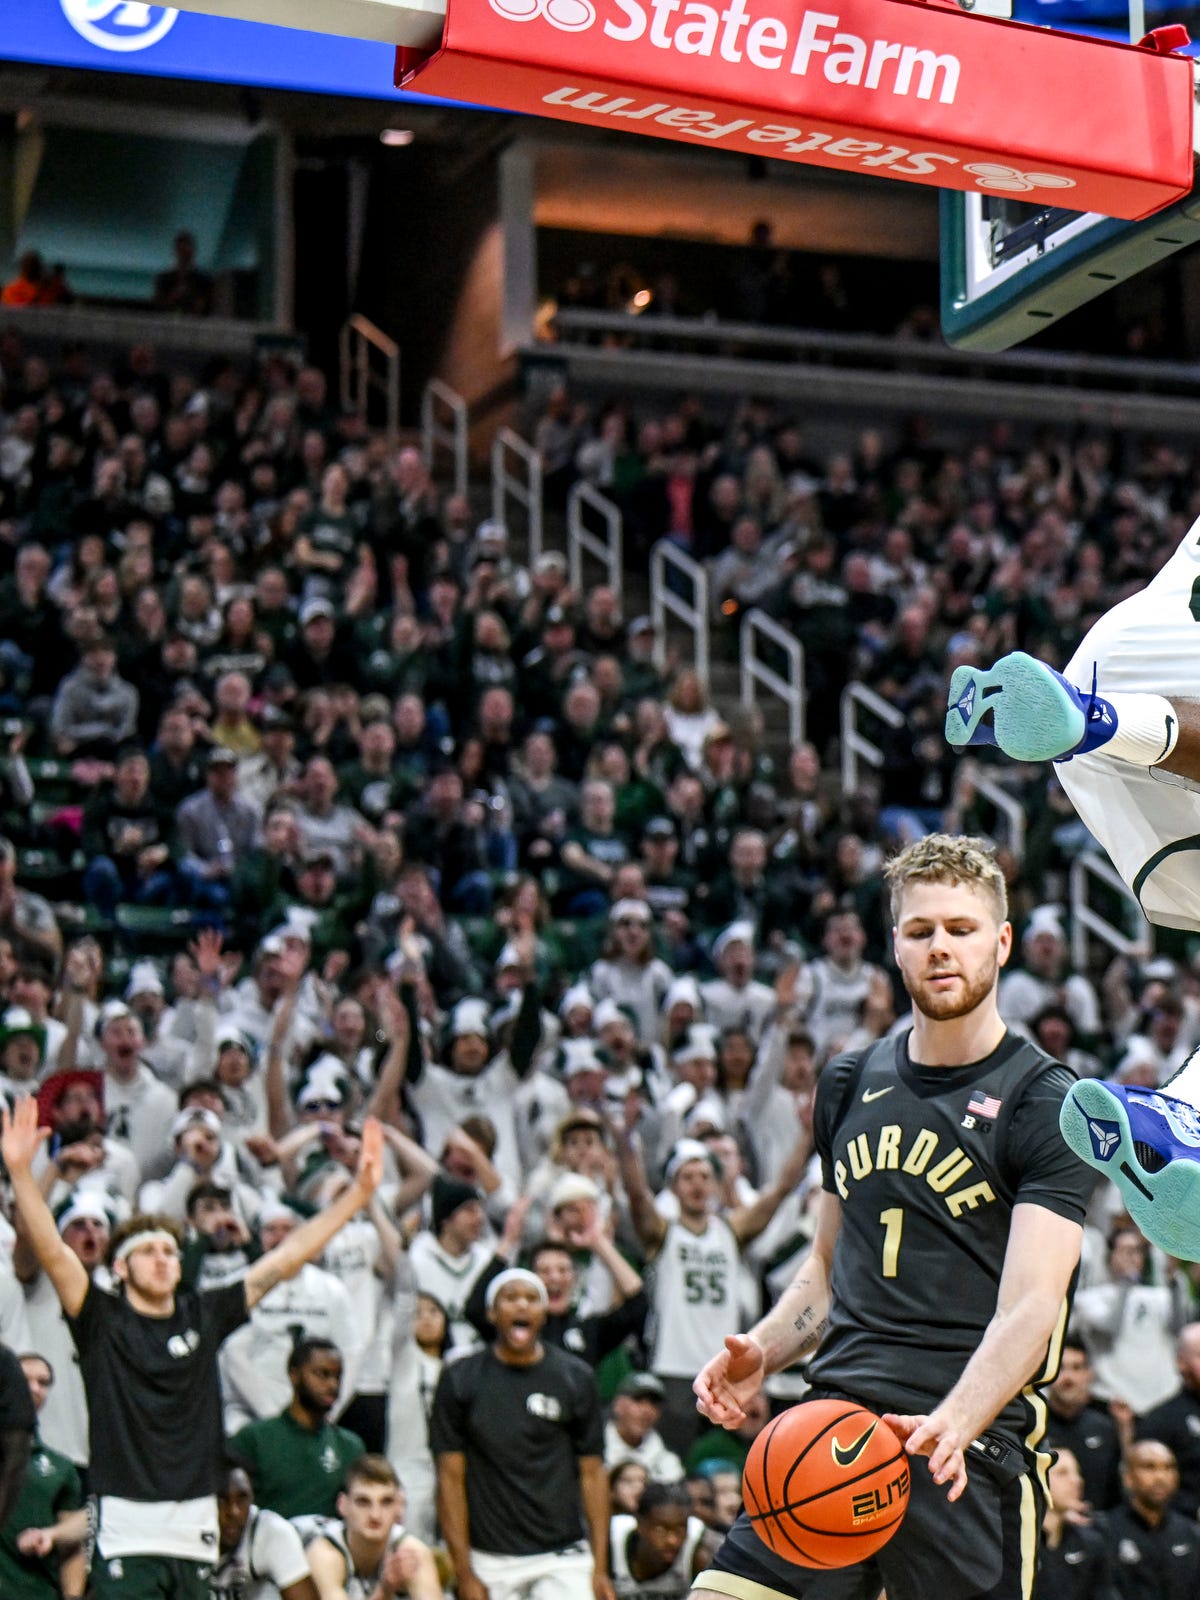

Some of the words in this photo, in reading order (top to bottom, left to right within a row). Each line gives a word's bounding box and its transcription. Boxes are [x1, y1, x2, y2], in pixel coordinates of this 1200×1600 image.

[834, 1124, 997, 1218] PURDUE
[879, 1207, 904, 1278] 1
[684, 1269, 727, 1306] 55
[852, 1468, 909, 1517] ELITE
